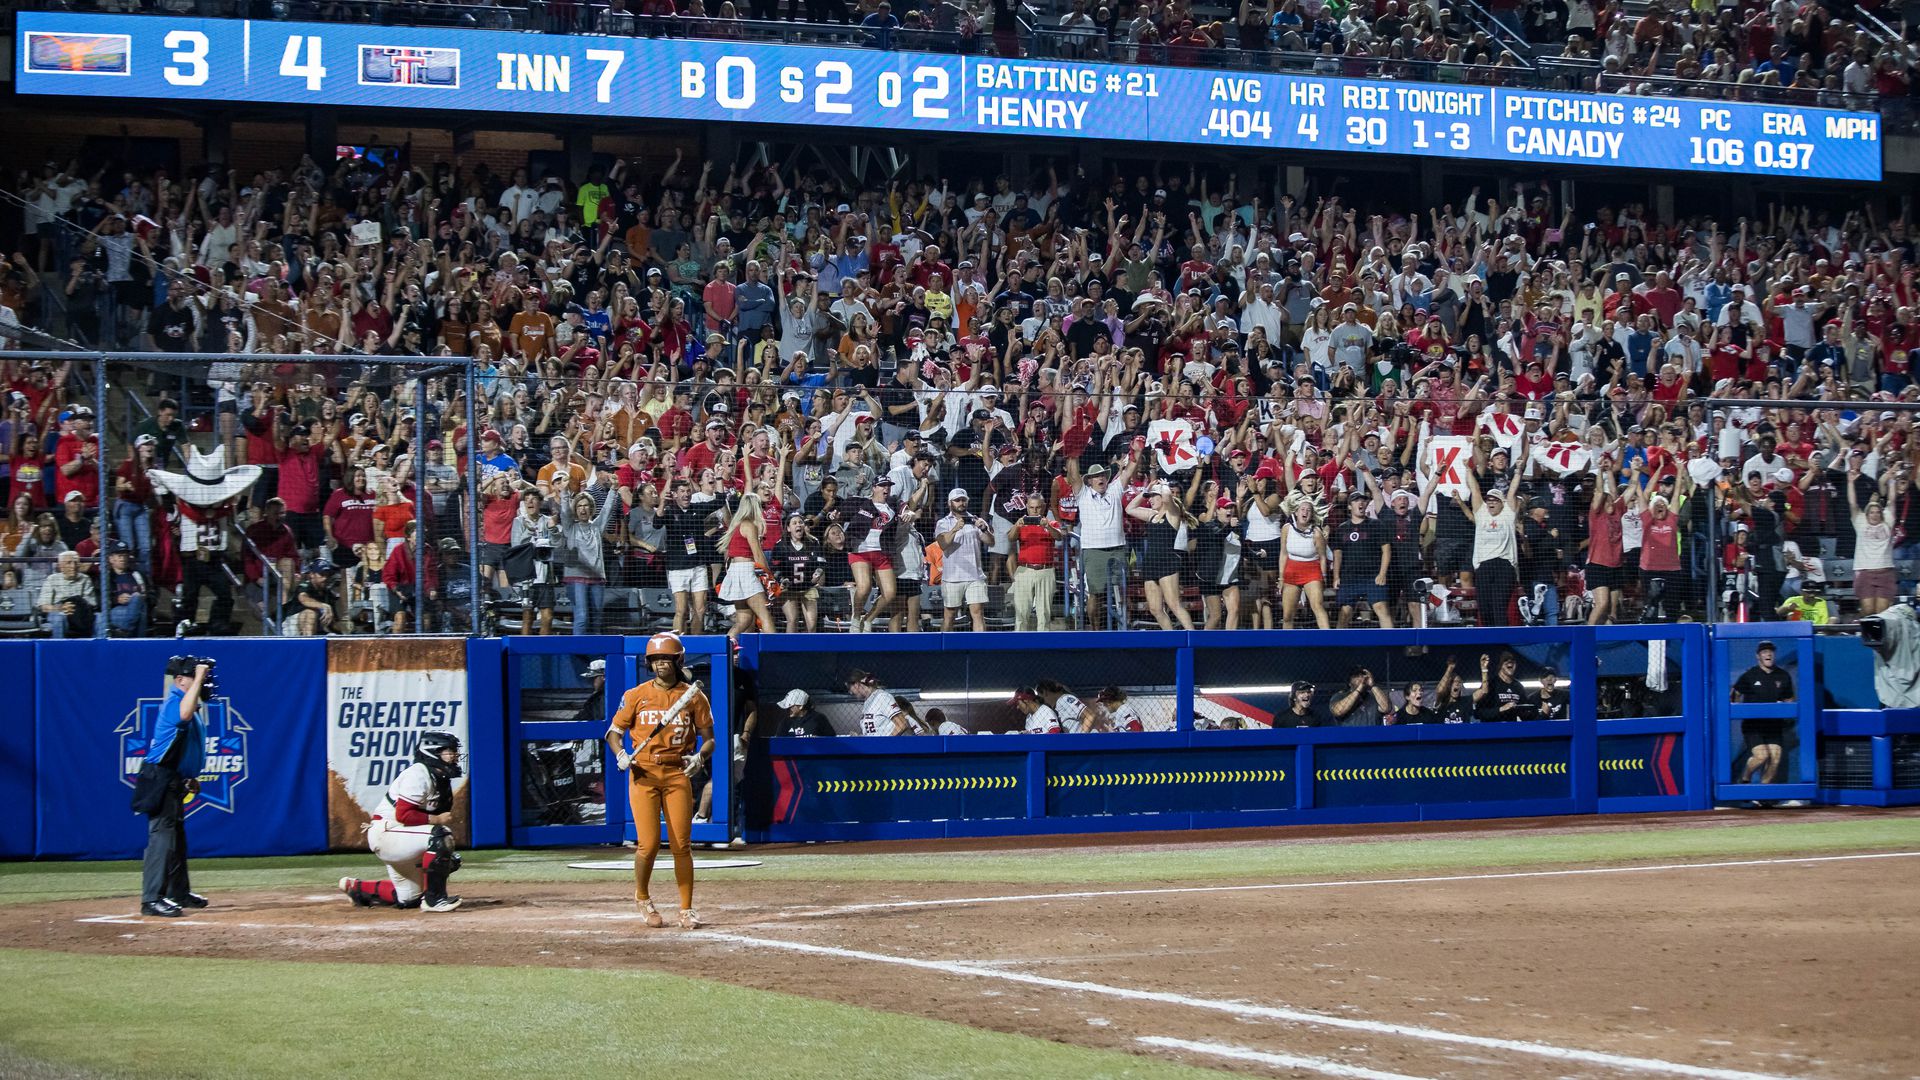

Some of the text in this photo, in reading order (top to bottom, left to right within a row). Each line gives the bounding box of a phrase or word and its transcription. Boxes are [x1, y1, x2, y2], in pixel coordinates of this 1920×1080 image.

[163, 30, 209, 86] 3
[279, 35, 327, 91] 4
[496, 48, 625, 104] INN 7
[681, 61, 706, 99] B
[780, 60, 853, 115] S 2
[912, 65, 950, 119] 2
[976, 63, 1159, 97] BATTING #21
[1210, 77, 1484, 116] AVG HR RBI TONIGHT
[977, 95, 1089, 130] HENRY
[1201, 108, 1471, 151] .404 4 30 1-3
[1505, 95, 1877, 141] PITCHING #24 PC ERA MPH
[1506, 126, 1815, 170] CANADY 106 0.97
[1160, 429, 1194, 466] K
[1435, 447, 1461, 484] K
[793, 563, 805, 584] 5
[340, 686, 364, 700] THE
[337, 700, 463, 729] GREATEST
[200, 754, 244, 774] RIES
